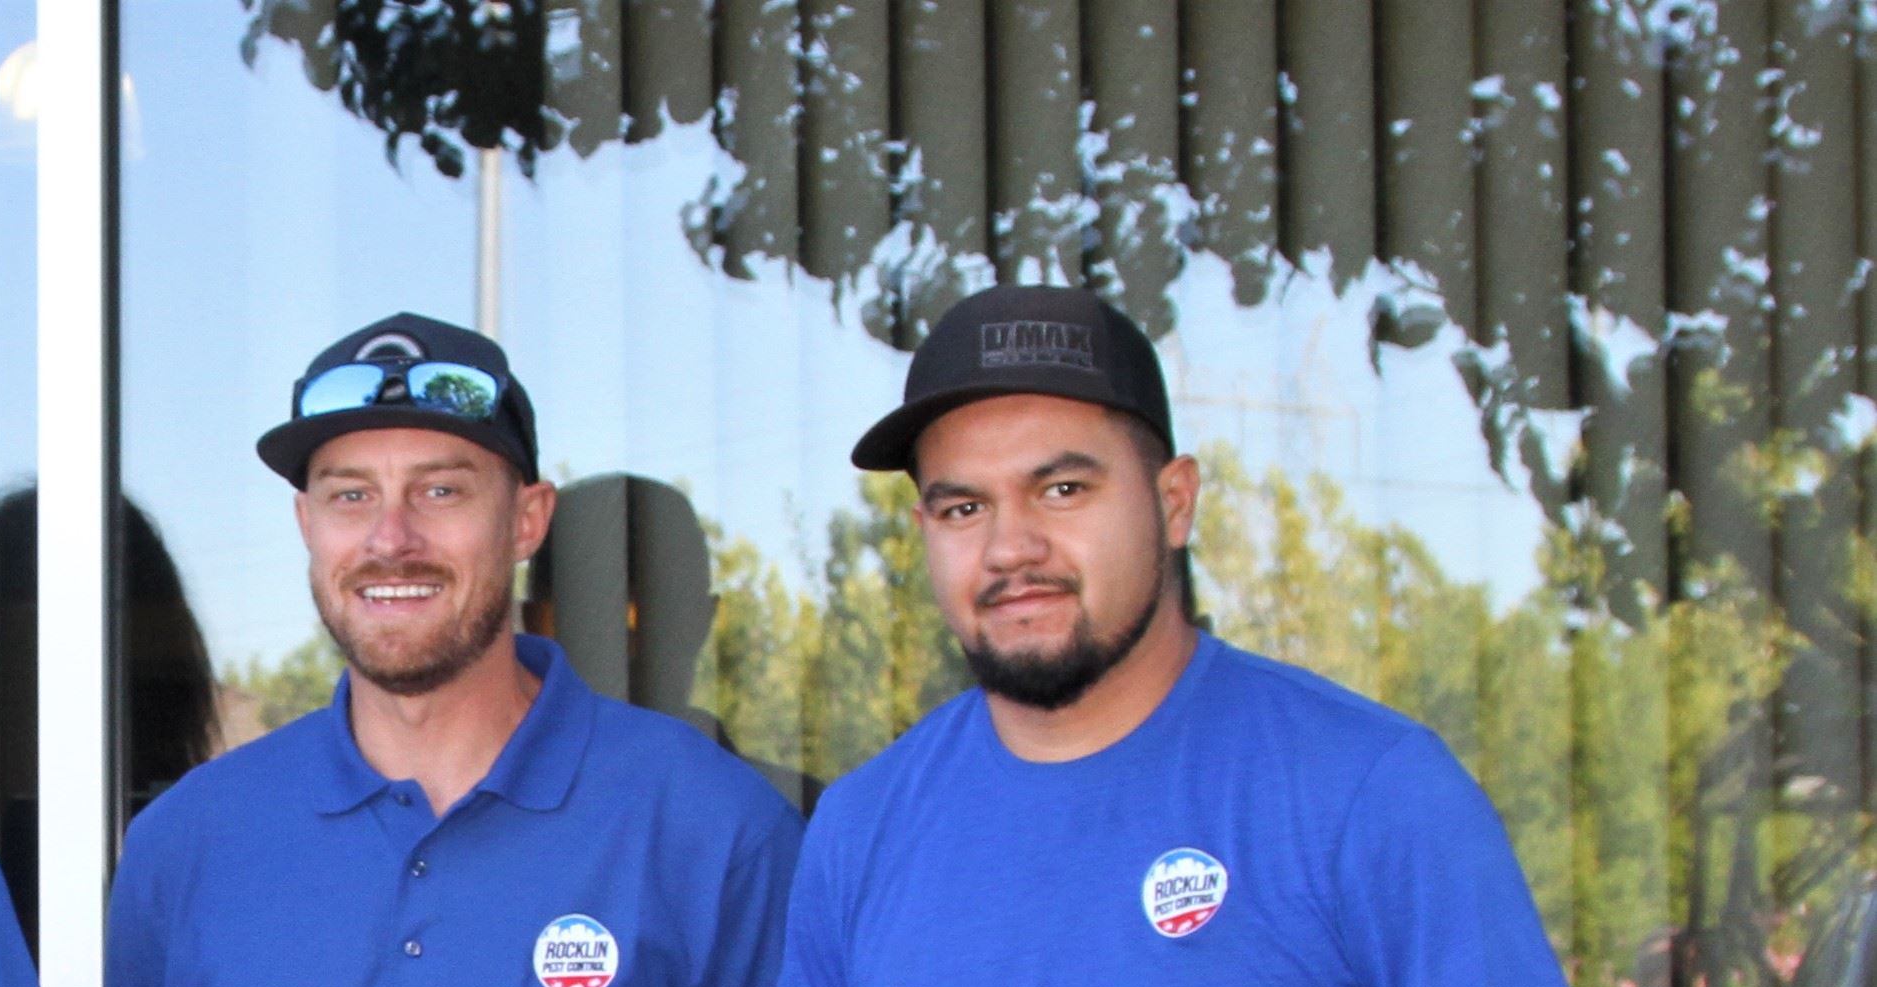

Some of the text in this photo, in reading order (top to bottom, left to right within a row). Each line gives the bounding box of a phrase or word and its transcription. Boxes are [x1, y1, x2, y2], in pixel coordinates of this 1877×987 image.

[1155, 873, 1219, 900] ROCKLIN
[1154, 894, 1214, 916] PEST CONTROL
[545, 942, 608, 959] ROCKLIN
[543, 962, 605, 972] PEST CONTROL
